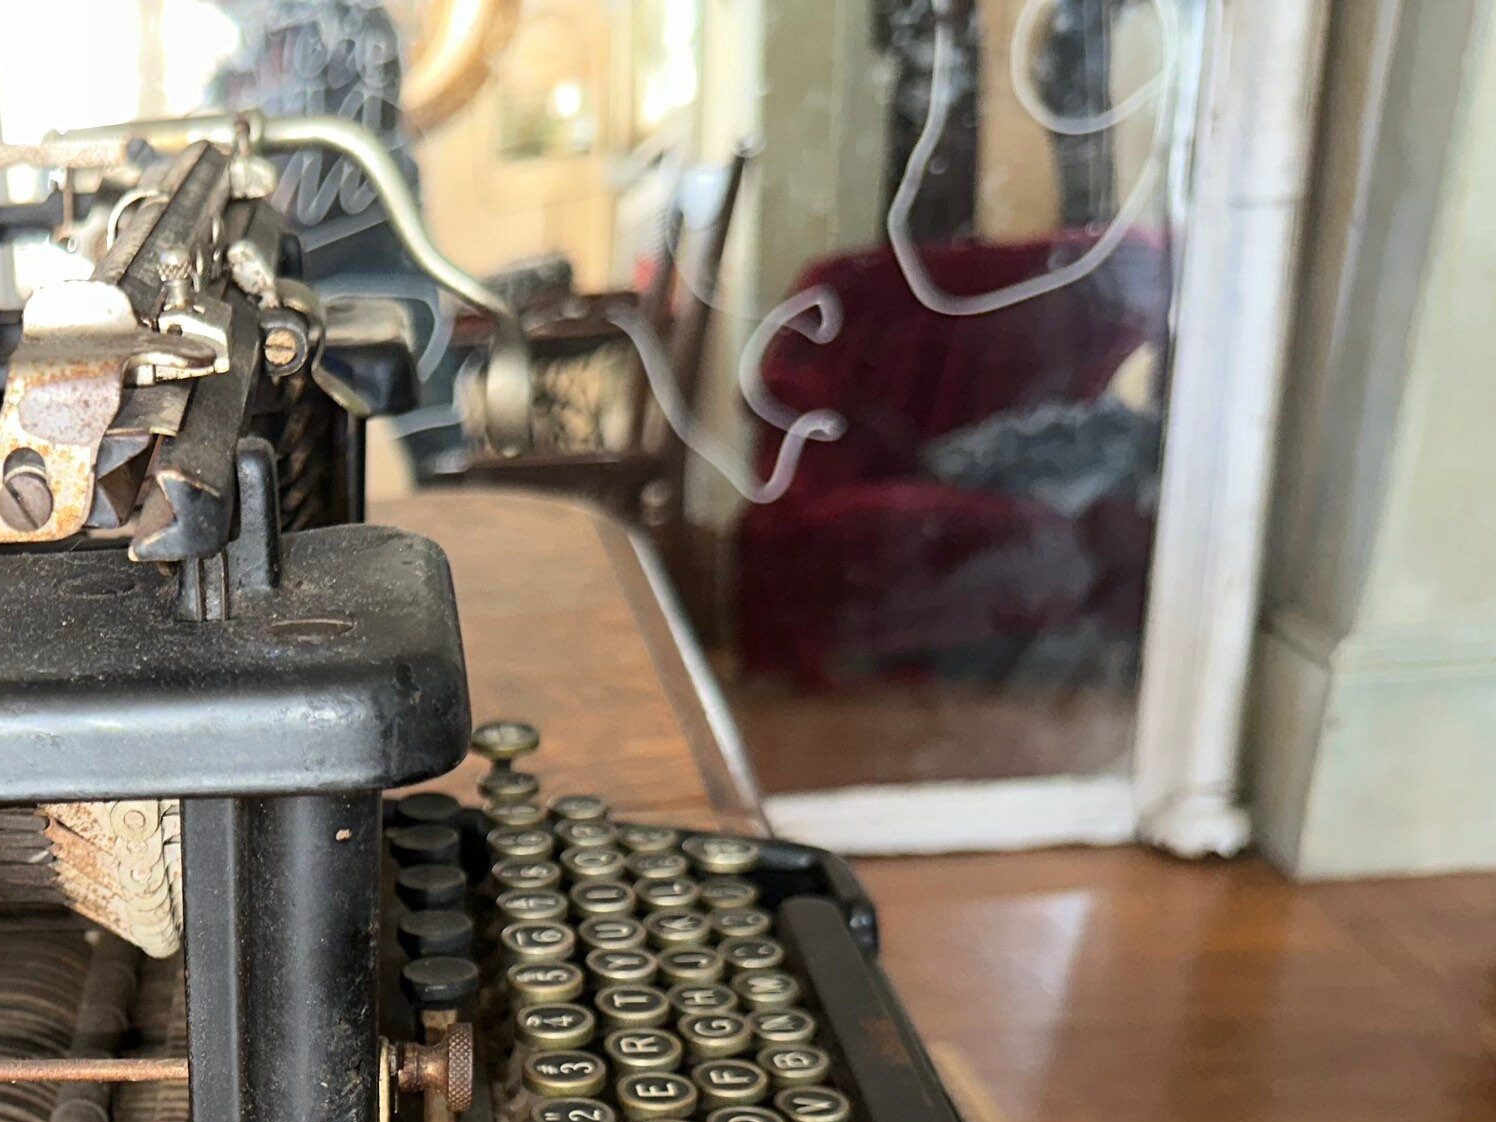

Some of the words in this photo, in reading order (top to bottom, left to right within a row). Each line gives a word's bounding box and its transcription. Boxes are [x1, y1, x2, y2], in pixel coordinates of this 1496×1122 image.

[531, 929, 562, 943] 6
[594, 922, 633, 939] U
[605, 954, 643, 969] Y
[672, 953, 709, 968] J
[536, 969, 568, 982] 5
[747, 977, 785, 994] M
[612, 994, 651, 1007] T
[681, 988, 718, 1006] H
[542, 1014, 575, 1028] 4
[694, 1018, 735, 1037] G
[757, 1014, 796, 1031] N
[620, 1035, 661, 1054] R
[560, 1061, 595, 1075] 3
[773, 1051, 812, 1070] B
[709, 1069, 753, 1085] F
[635, 1081, 680, 1098] E
[792, 1096, 833, 1114] V
[568, 1109, 601, 1122] 2
